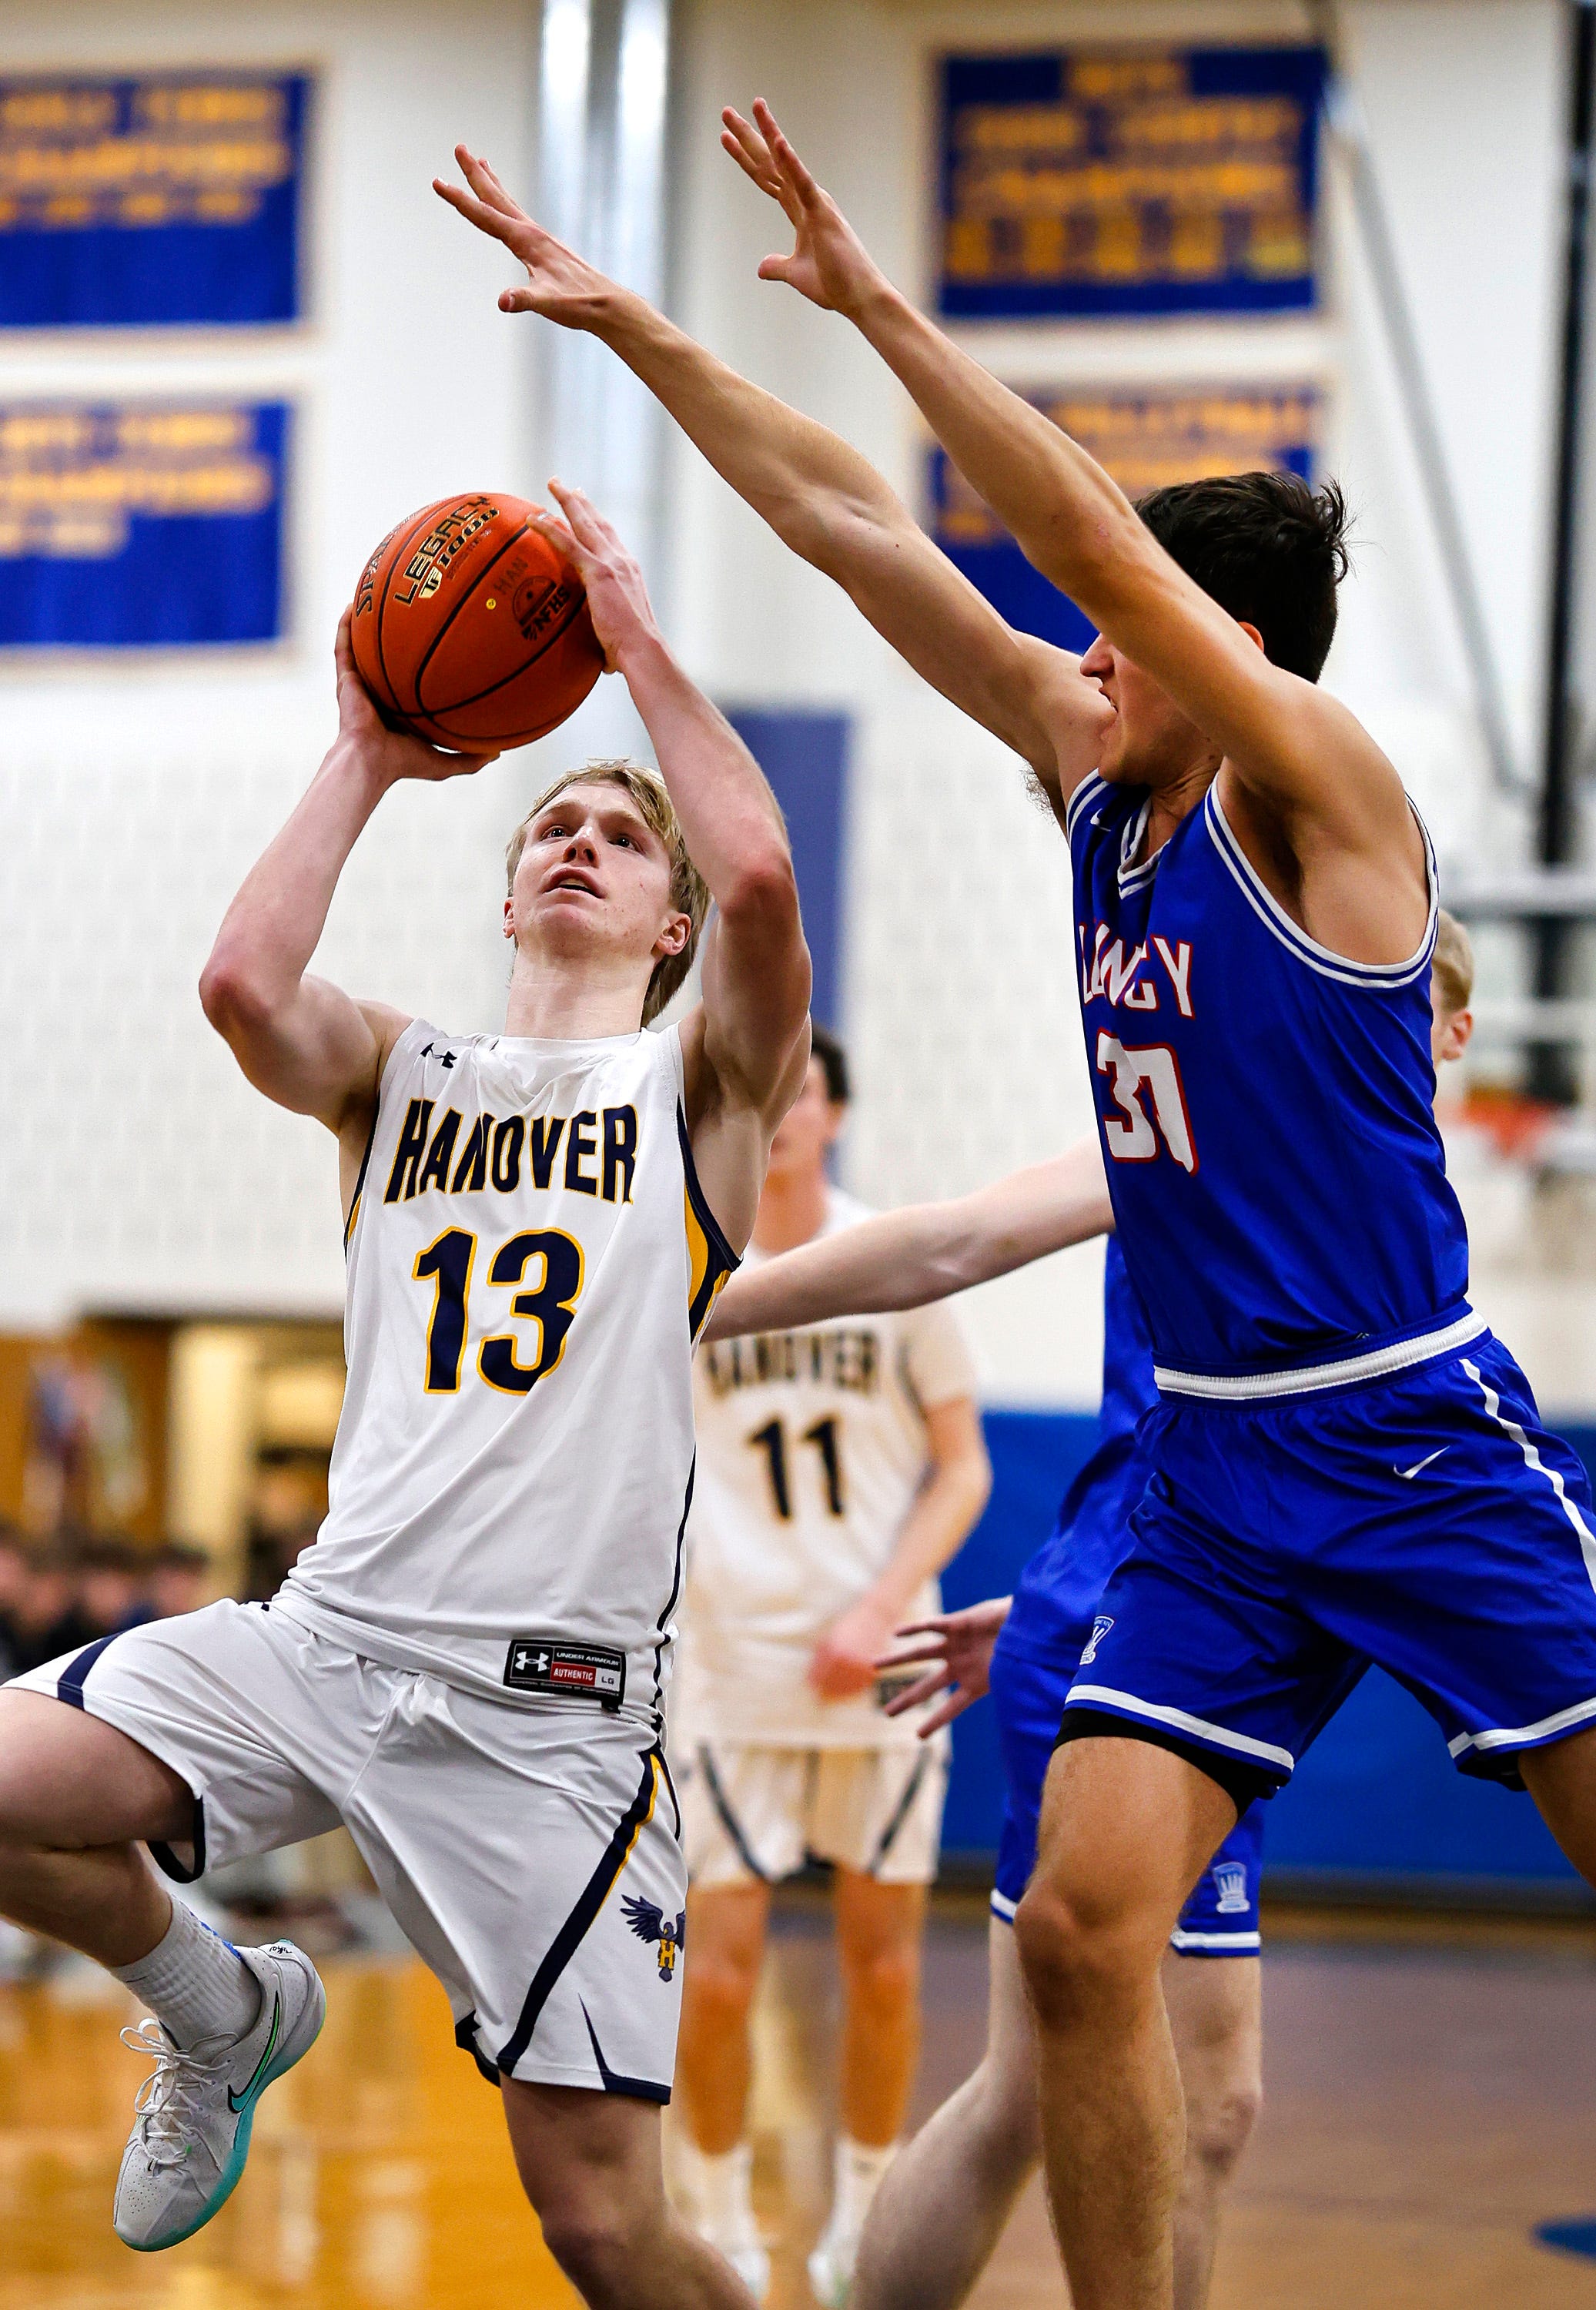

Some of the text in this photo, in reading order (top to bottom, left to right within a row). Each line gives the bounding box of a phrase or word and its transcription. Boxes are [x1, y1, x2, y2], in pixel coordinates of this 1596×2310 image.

[393, 496, 490, 607] LEGACY
[437, 507, 500, 569] 1000
[534, 585, 571, 632] NFHS
[383, 1097, 638, 1206] HANOVER
[412, 1225, 585, 1396] 13
[744, 1411, 845, 1522] 11
[554, 1668, 615, 1685] AUTHENTIC LG
[557, 1652, 619, 1666] UNDER ARMOUR
